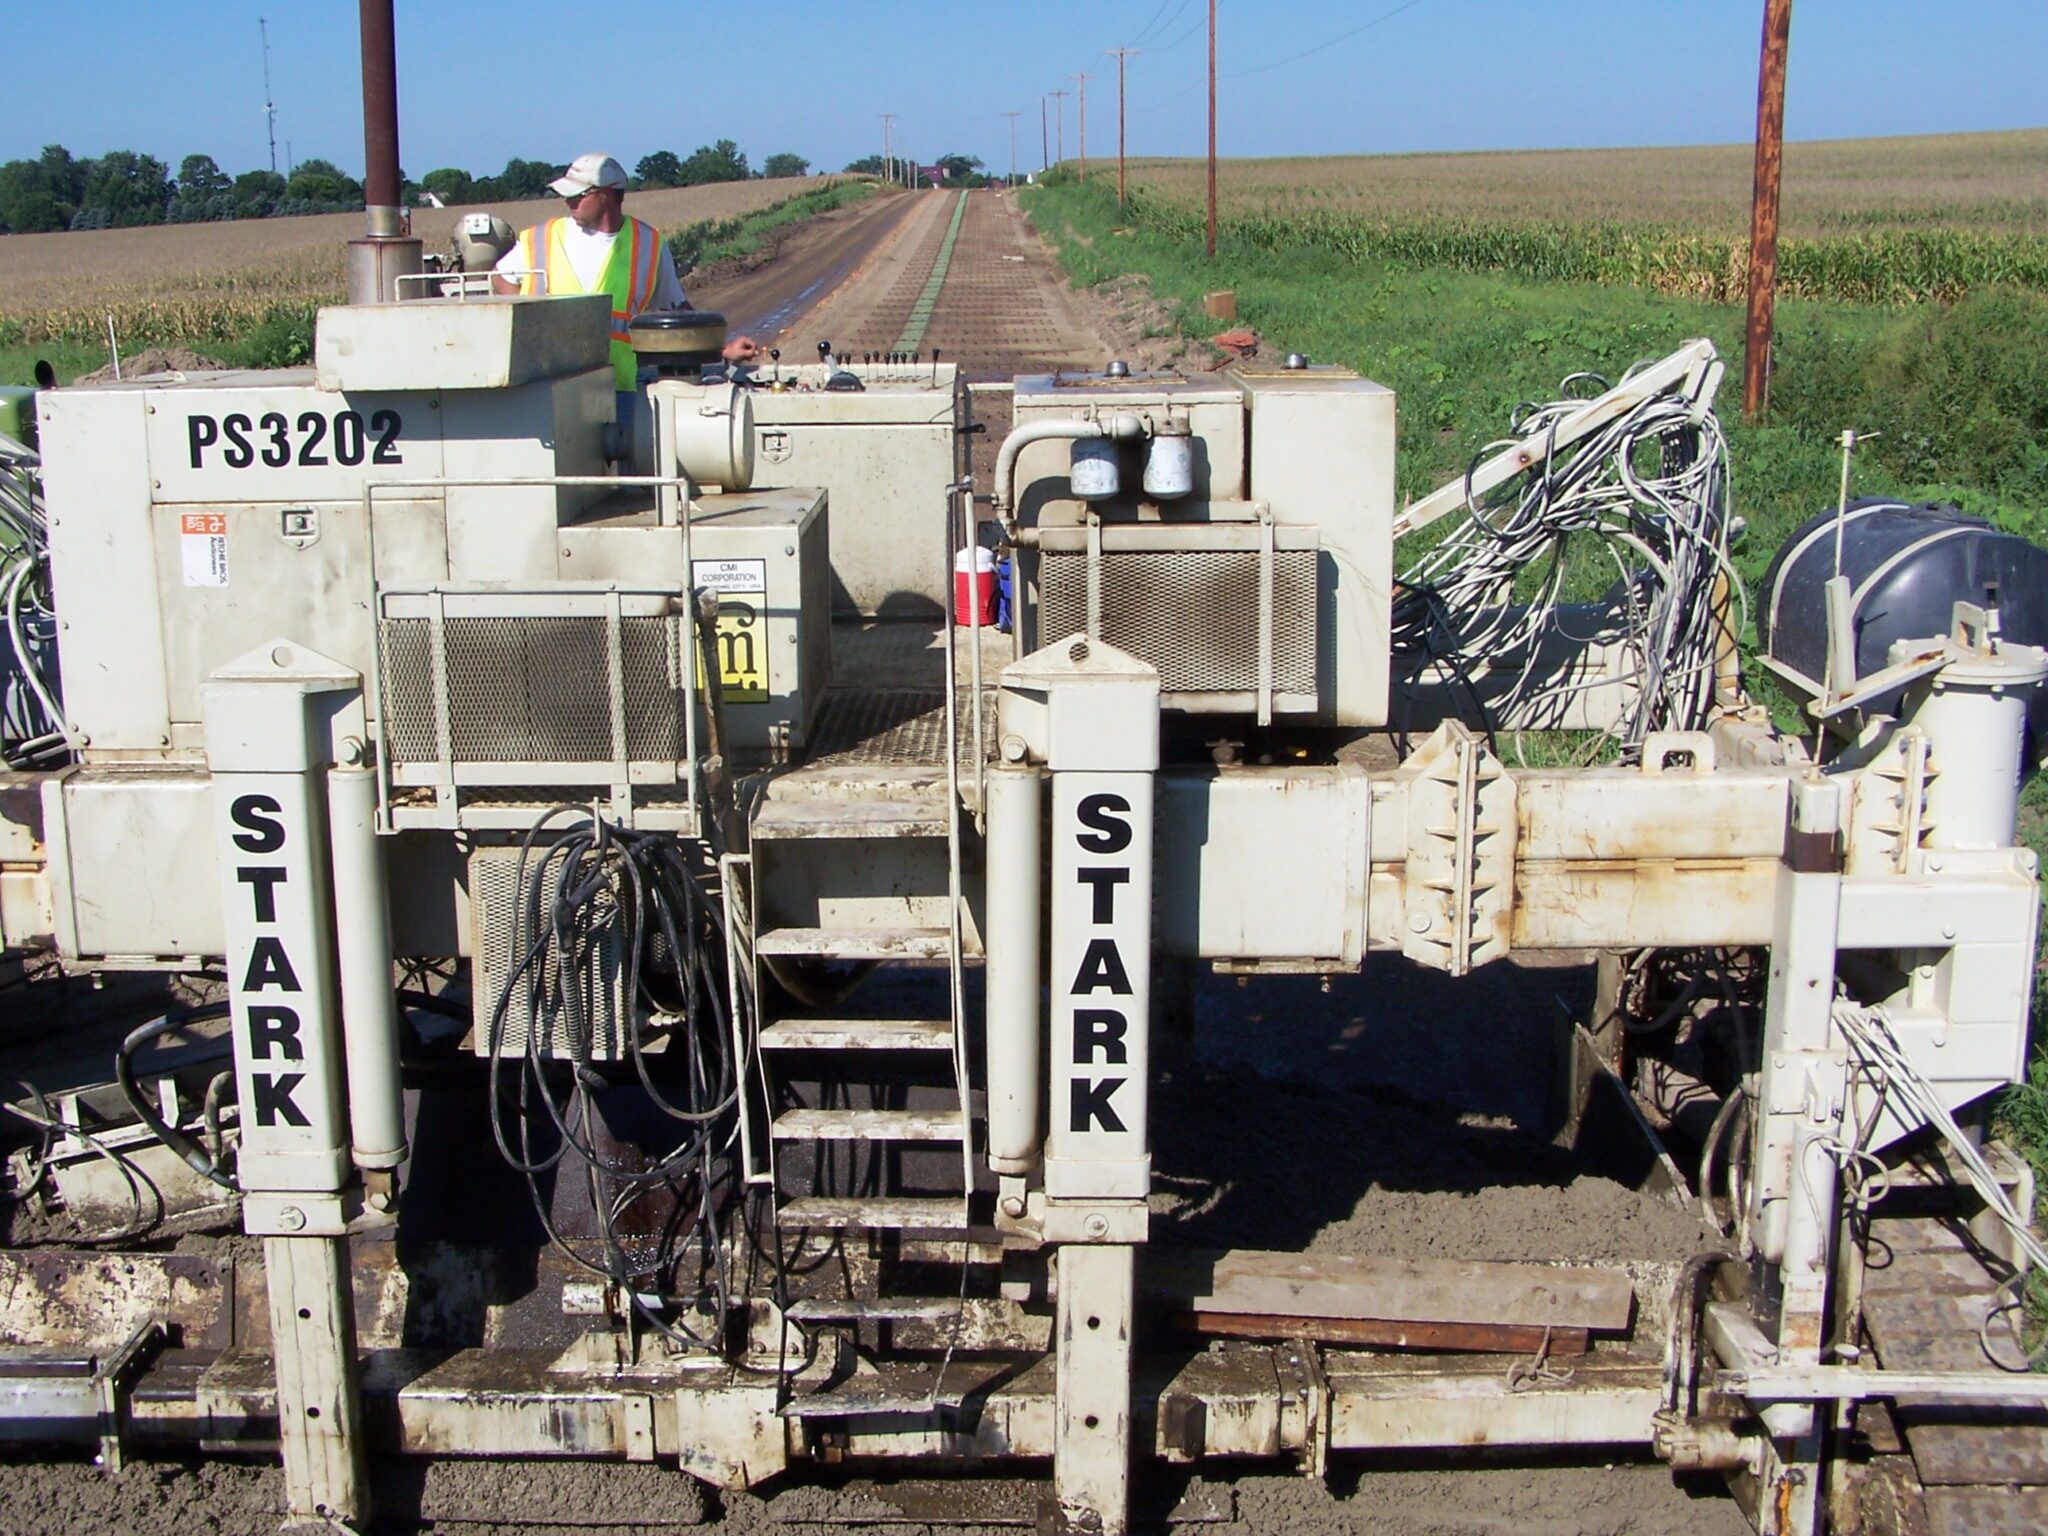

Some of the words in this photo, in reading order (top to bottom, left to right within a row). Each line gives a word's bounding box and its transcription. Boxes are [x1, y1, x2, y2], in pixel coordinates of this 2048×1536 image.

[188, 410, 403, 468] PS3202
[196, 516, 205, 532] LOT
[702, 573, 757, 582] CORPORATION
[720, 563, 738, 572] CMI
[232, 794, 311, 1127] STARK
[1070, 793, 1133, 1132] STARK
